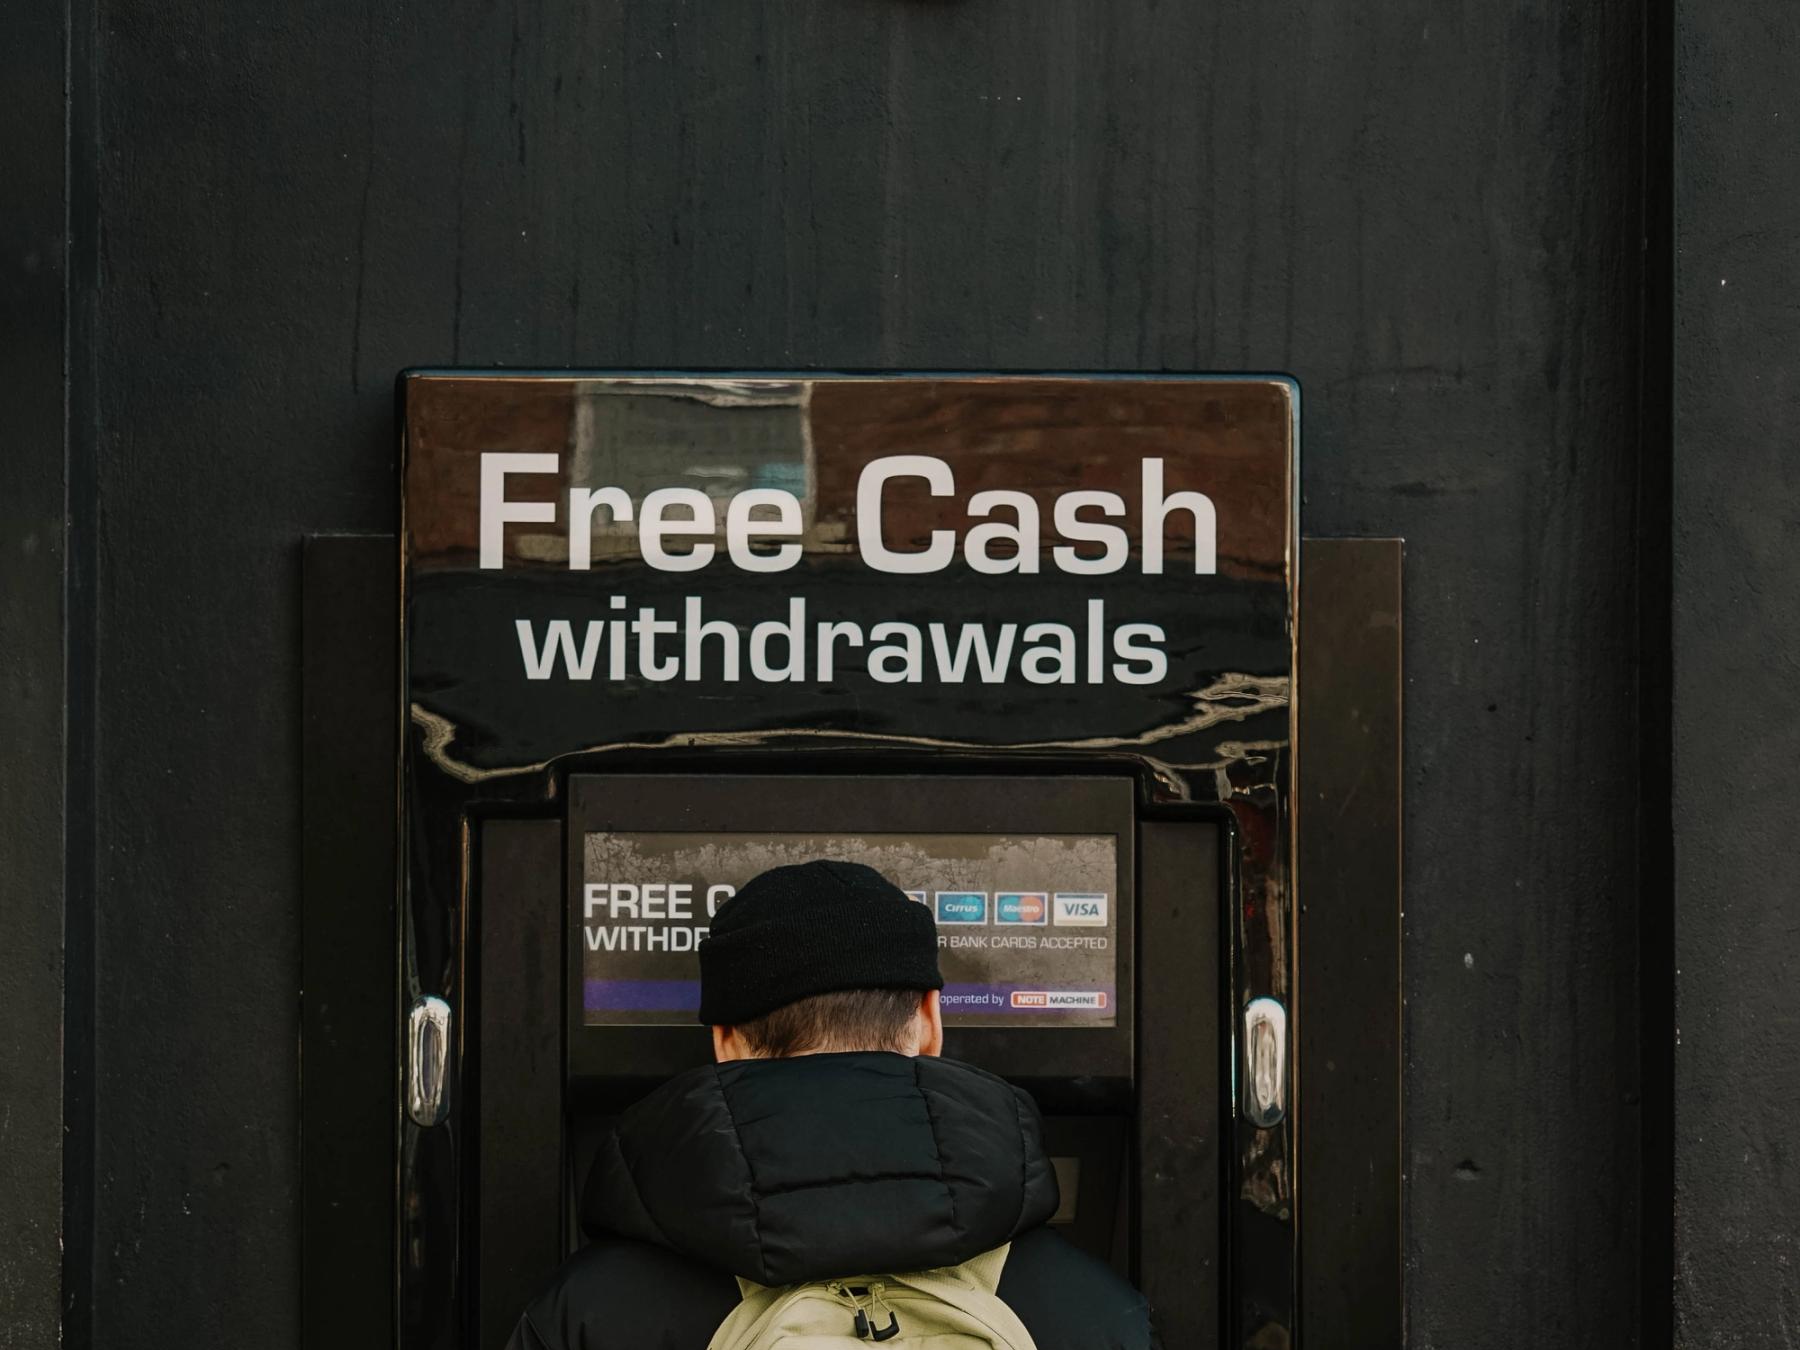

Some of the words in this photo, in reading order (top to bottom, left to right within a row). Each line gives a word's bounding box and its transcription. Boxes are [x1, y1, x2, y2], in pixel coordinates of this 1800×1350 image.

[479, 452, 804, 573] Free
[856, 454, 1218, 576] Cash
[515, 595, 1169, 686] withdrawals
[585, 883, 693, 919] FREE
[1064, 903, 1099, 916] VISA
[951, 936, 988, 949] BANK
[991, 937, 1037, 949] CARDS
[1040, 937, 1107, 949] ACCEPTED
[992, 994, 1004, 1006] by
